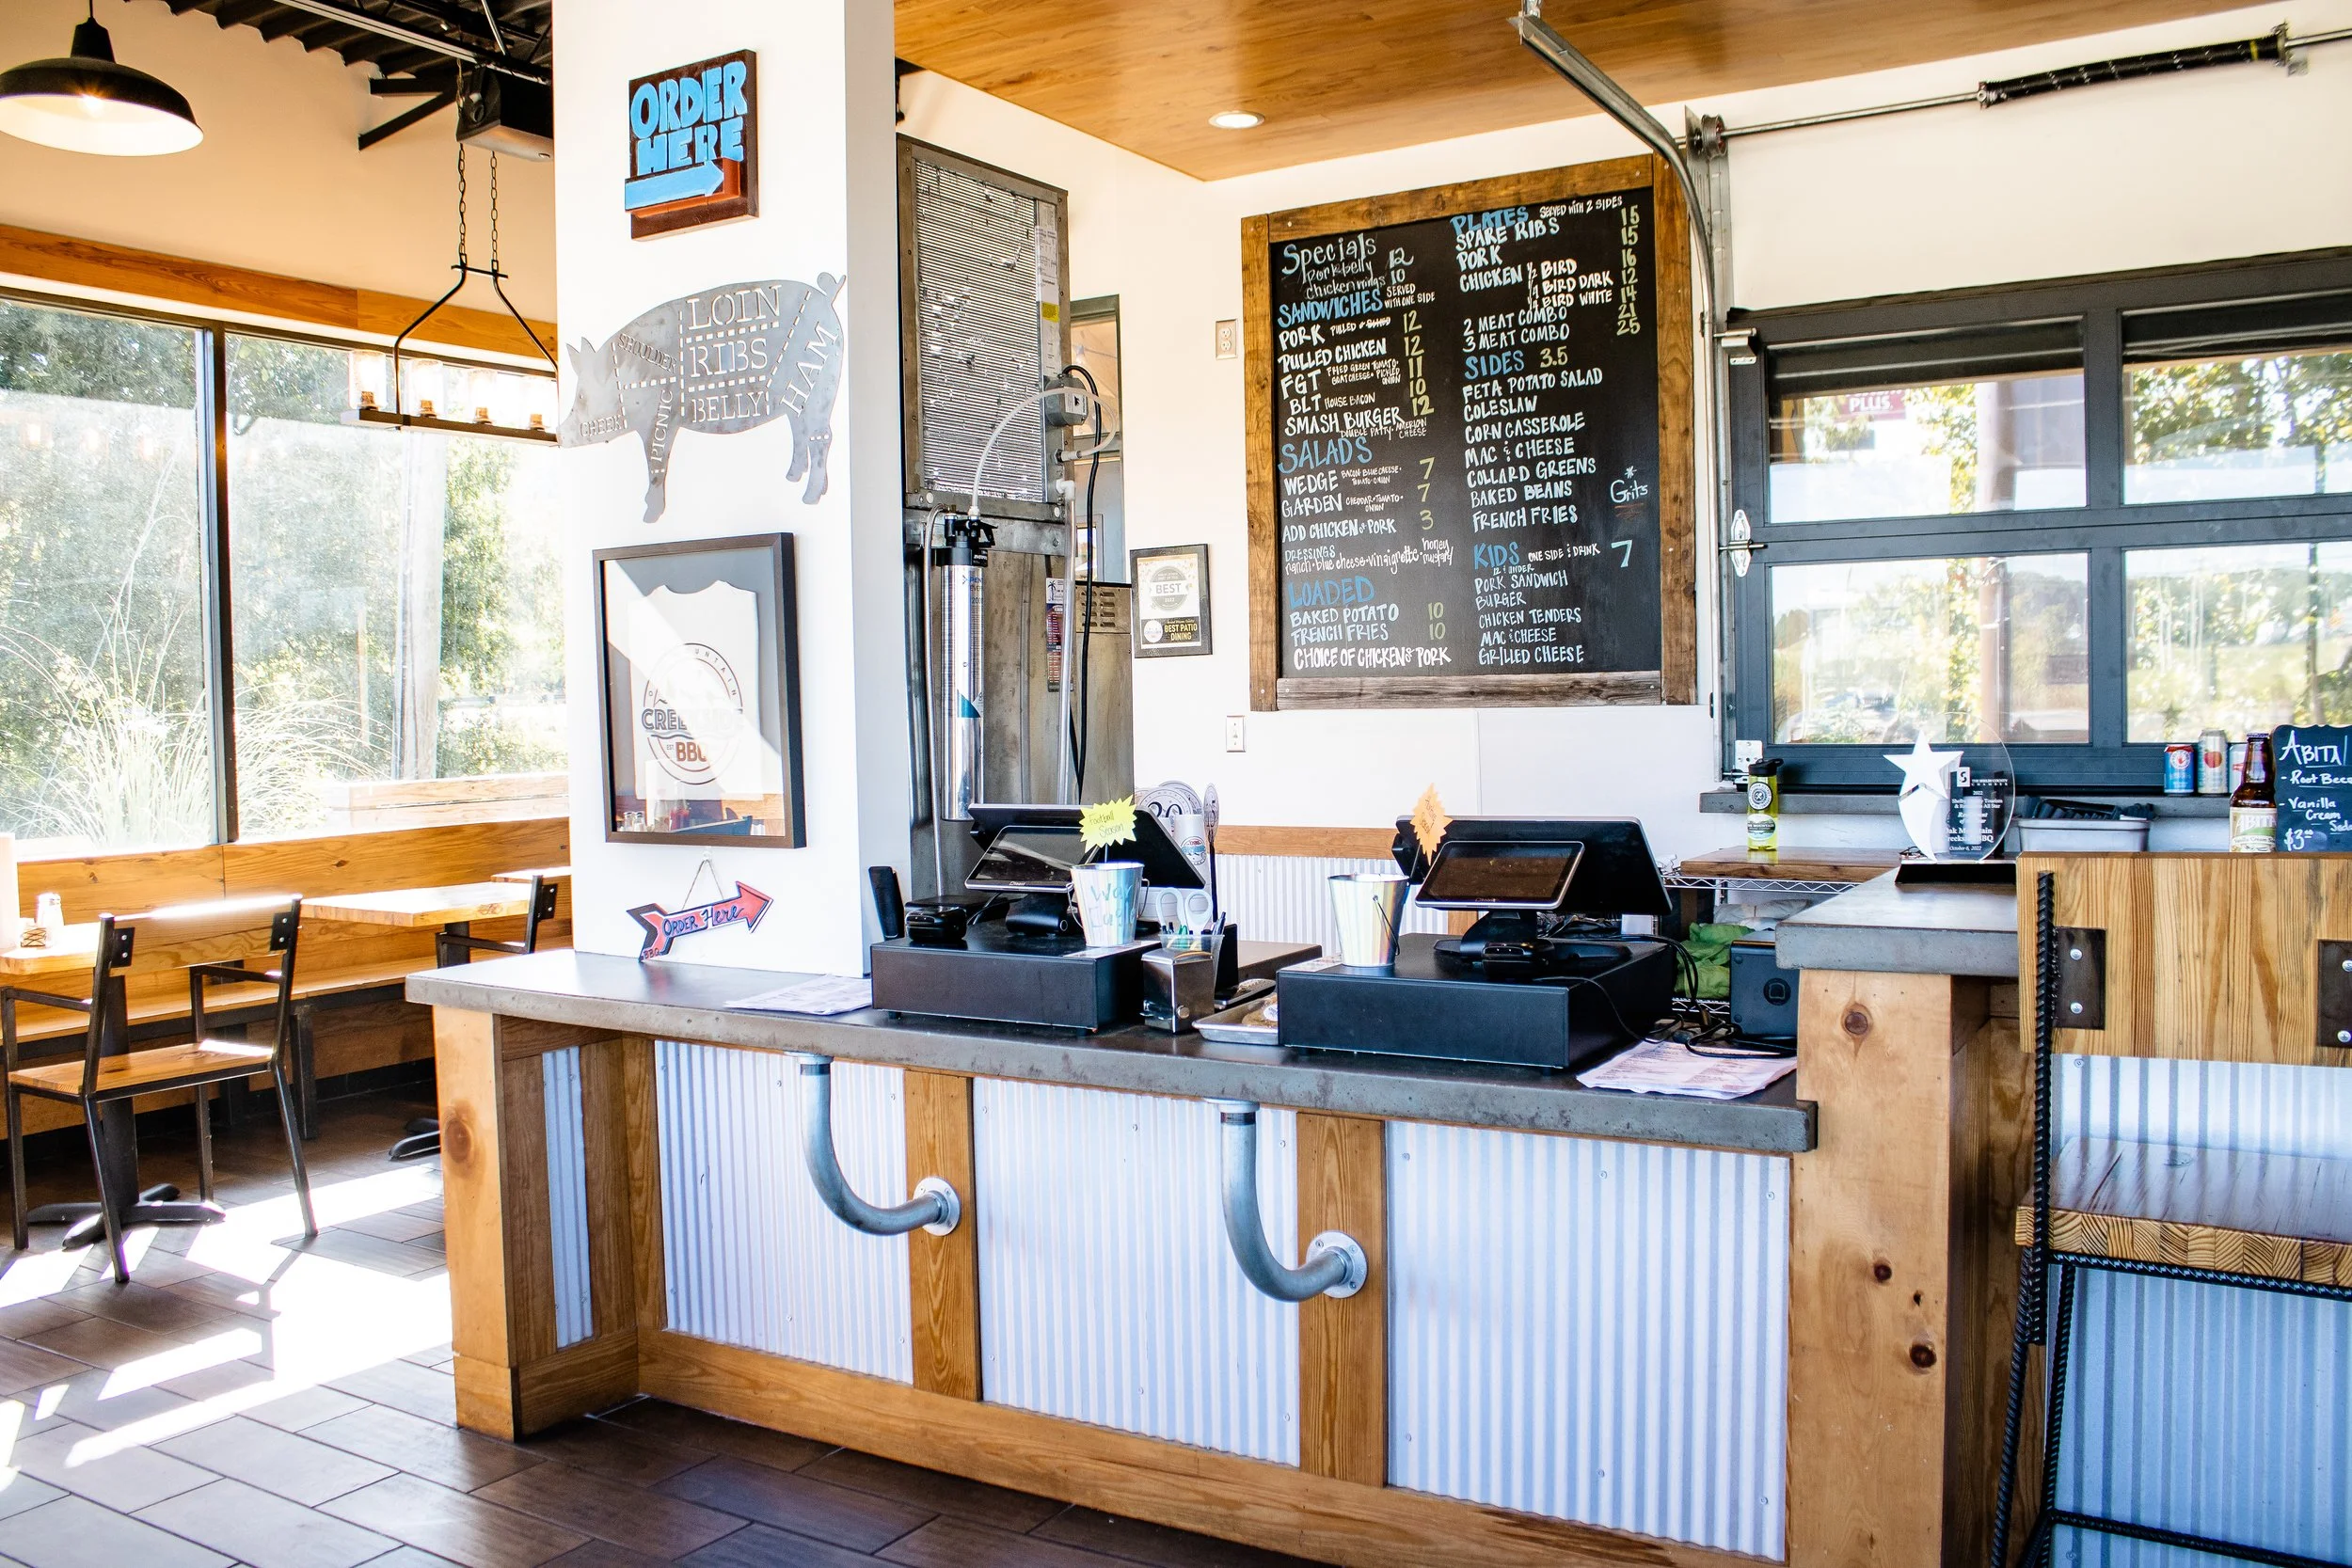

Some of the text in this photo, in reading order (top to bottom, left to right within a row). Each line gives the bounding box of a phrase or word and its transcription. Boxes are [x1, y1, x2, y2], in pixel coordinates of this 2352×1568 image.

[630, 60, 748, 139] ORDER
[637, 116, 744, 176] HERE
[1450, 206, 1529, 236] PLATES
[1539, 206, 1566, 219] SERVED
[1586, 199, 1594, 214] 2
[1596, 195, 1623, 211] SIDES
[1455, 205, 1640, 252] SPARE RIBS 15
[1281, 232, 1376, 284] Specials
[1390, 246, 1414, 269] 12
[1456, 225, 1639, 272] PORK 15
[1391, 268, 1406, 285] 10
[1459, 248, 1637, 293] CHICKEN BIRD 16
[1542, 267, 1639, 296] BIRD DARK 12
[686, 284, 782, 331] LOIN
[1278, 283, 1416, 328] SANDWICHES SERVED
[1384, 292, 1436, 309] WITH ONE SIDE
[1542, 284, 1637, 309] BIRD WHITE 14
[1279, 309, 1422, 352] PORK PULLED 12
[1462, 317, 1641, 353] 3 MEAT COMBO 25
[1463, 302, 1637, 337] 2 MEAT COMBO 21
[617, 333, 677, 375] SHOULDER
[689, 338, 768, 378] RIBS
[1278, 335, 1424, 373] PULLED CHICKEN 12
[1464, 345, 1568, 380] SIDES 3.5
[779, 321, 839, 419] HAM
[1280, 356, 1422, 400] FGT FRIED GREEN 11
[1462, 367, 1603, 404] FETA POTATO SALAD
[691, 390, 764, 423] BELLY
[1290, 378, 1426, 416] BLT HOUSE BACON 10
[1463, 395, 1538, 422] COLESLAW
[1848, 395, 1891, 413] PLUS
[580, 414, 622, 438] CHEEK
[650, 389, 674, 463] PICNIC
[1284, 395, 1435, 436] SMASH BURGER 12
[1339, 417, 1427, 440] DOUBLE PATTY AMERICAN
[1465, 411, 1586, 444] CORN CASSEROLE
[1399, 428, 1427, 439] CHEESE
[1278, 436, 1373, 474] SALADS
[1465, 436, 1575, 469] MAC CHEESE
[1283, 469, 1338, 496] WEDGE
[1419, 456, 1435, 480] 7
[1467, 457, 1597, 488] COLLARD GREENS
[1281, 493, 1343, 517] GARDEN
[1345, 495, 1374, 506] CHEDDAR
[1417, 483, 1430, 502] 7
[1470, 480, 1573, 509] BAKED BEANS
[1610, 480, 1648, 503] Grits
[1282, 509, 1434, 544] ADD CHICKEN PORK 3
[1472, 505, 1579, 533] FRENCH FRIES
[1285, 545, 1336, 562] DRESSINGS
[1285, 537, 1450, 576] ranch blue cheese vinaigrette honey
[1422, 546, 1454, 566] mustard
[1473, 539, 1633, 570] KIDS ONE SIDE DRINK 7
[1155, 583, 1182, 594] BEST
[1286, 575, 1375, 610] LOADED
[1474, 569, 1569, 594] PORK SANDWICH
[1289, 602, 1444, 628] BAKED POTATO 10
[1475, 592, 1527, 611] BURGER
[1164, 623, 1198, 633] BEST PATIO
[1479, 607, 1581, 629] CHICKEN TENDERS
[1170, 632, 1192, 641] DINING
[1290, 622, 1446, 647] FRENCH FRIES 10
[1480, 626, 1557, 647] MAC CHEESE
[1294, 646, 1452, 670] CHOICE OF CHICKEN PORK
[1478, 644, 1584, 667] GRILLED CHEESE
[2279, 730, 2343, 766] ABITA
[2290, 769, 2318, 784] Root
[1089, 810, 1115, 826] Football
[2288, 797, 2336, 809] Vanilla
[2305, 810, 2342, 820] Cream
[1098, 823, 1125, 839] Season
[1090, 883, 1134, 903] War
[700, 905, 744, 923] Here
